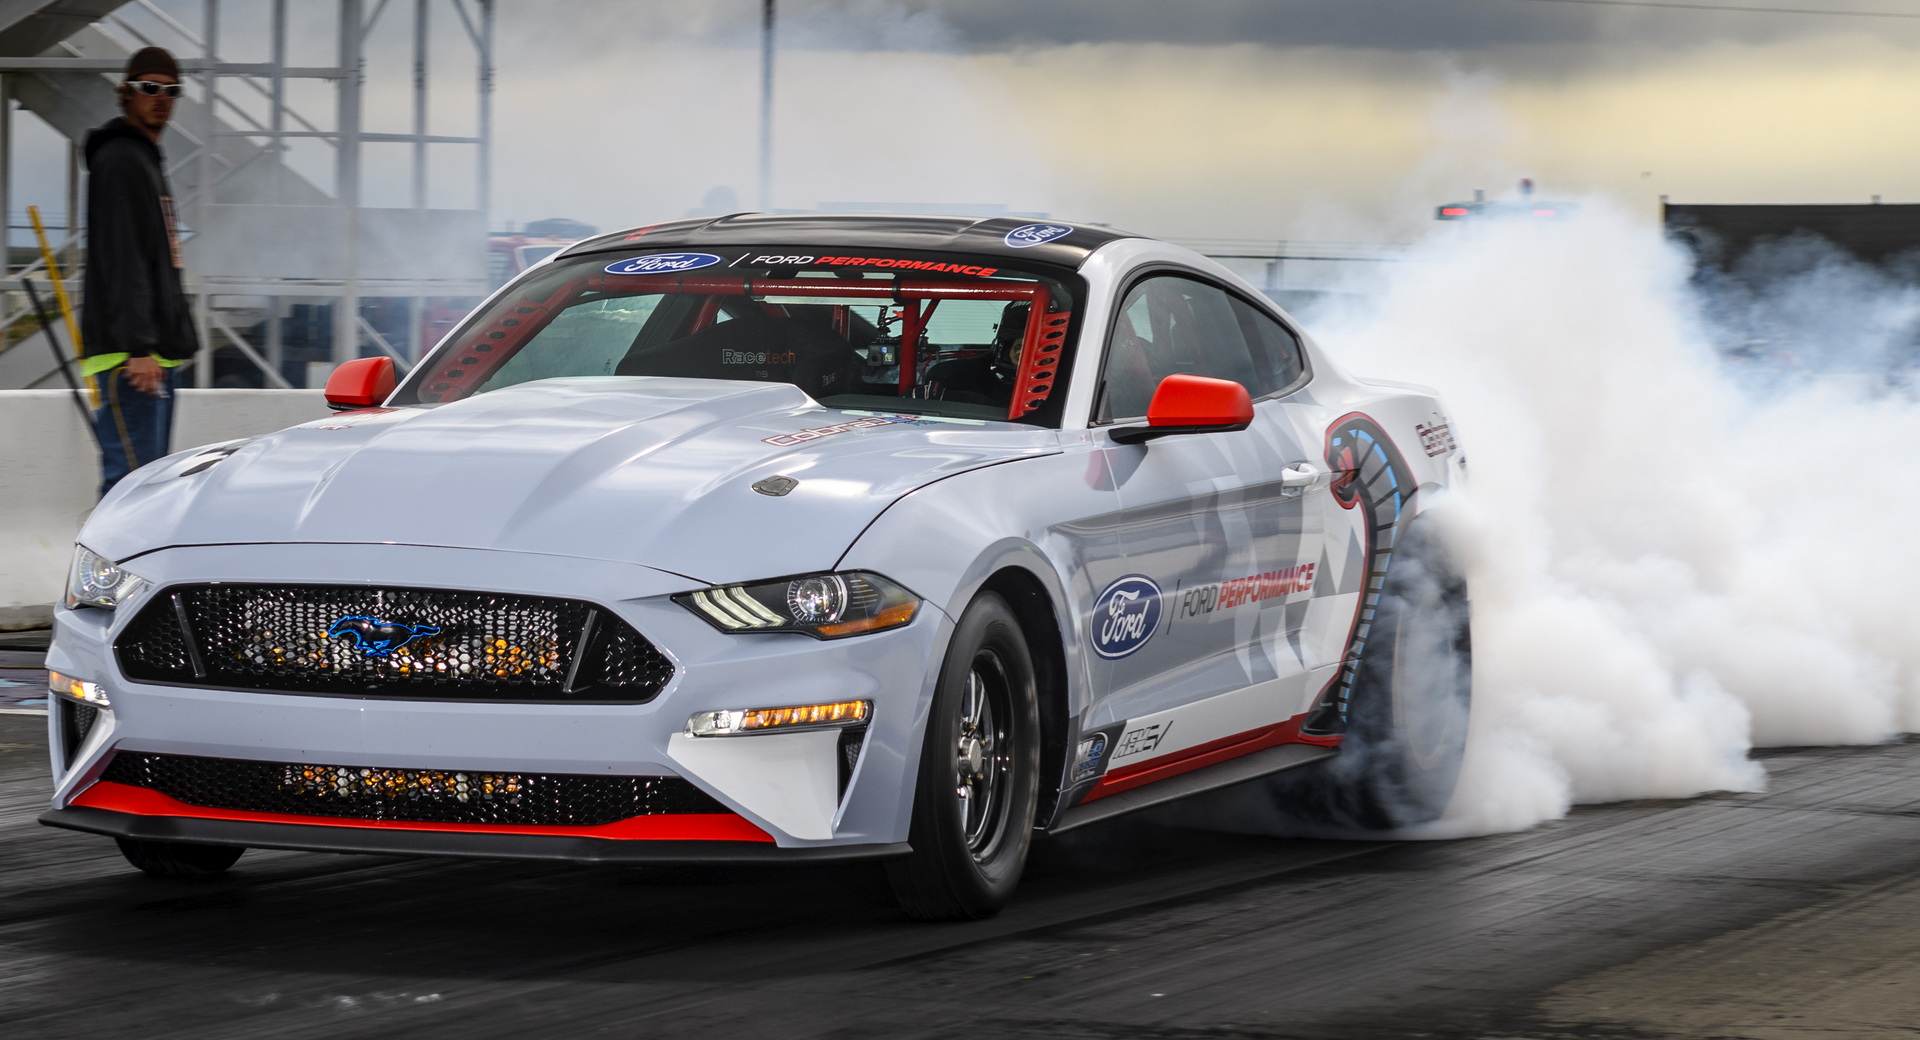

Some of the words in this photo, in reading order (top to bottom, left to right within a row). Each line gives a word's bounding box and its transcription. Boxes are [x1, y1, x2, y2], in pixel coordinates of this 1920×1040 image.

[1014, 223, 1064, 243] Ford
[624, 255, 700, 272] Ford
[750, 255, 815, 265] FORD
[814, 256, 998, 277] PERFORMANCE
[722, 348, 796, 364] Racetech
[1179, 584, 1219, 620] FORD
[1216, 562, 1315, 611] PERFORMANCE
[1102, 590, 1150, 645] Ford
